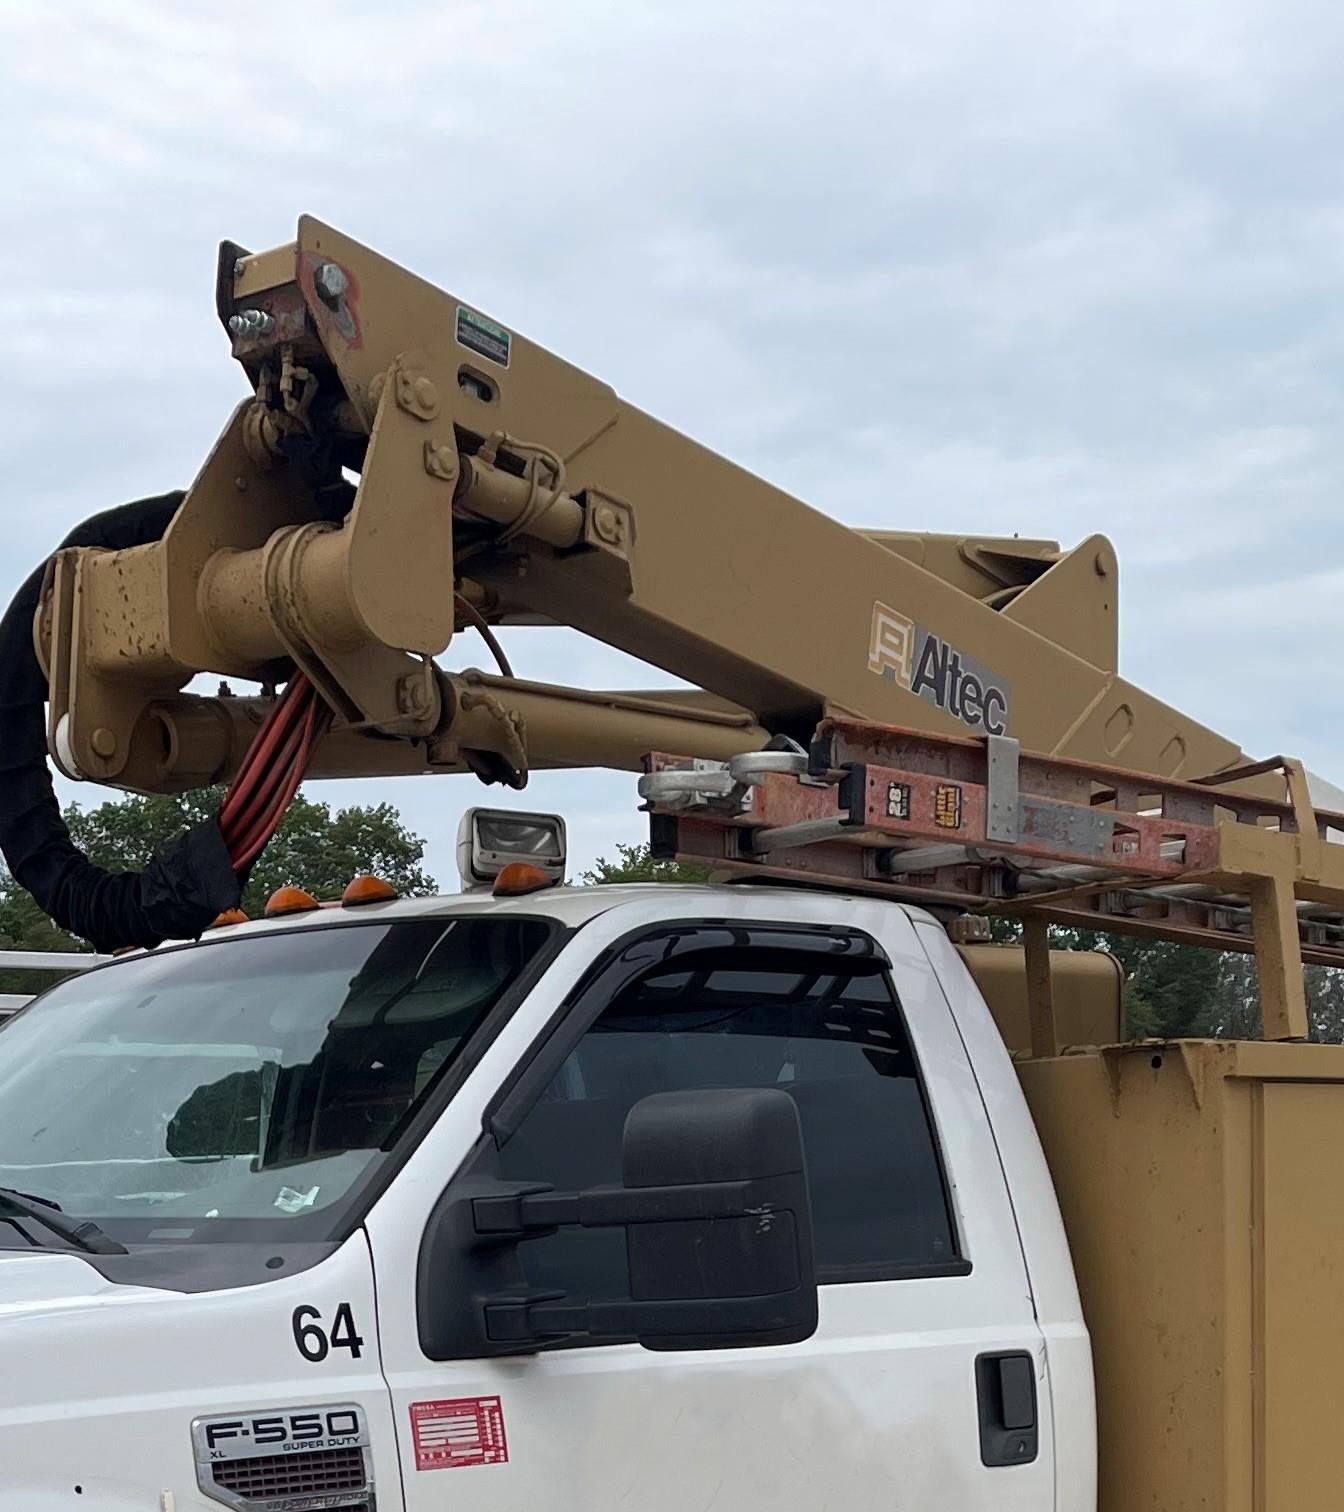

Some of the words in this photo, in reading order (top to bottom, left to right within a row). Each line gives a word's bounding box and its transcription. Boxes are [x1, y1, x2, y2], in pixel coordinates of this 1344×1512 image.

[911, 634, 1006, 736] Altec
[292, 1302, 364, 1362] 64
[206, 1410, 359, 1449] F-550
[283, 1439, 324, 1452] SUPER
[328, 1436, 360, 1447] DUTY
[210, 1451, 227, 1460] XL
